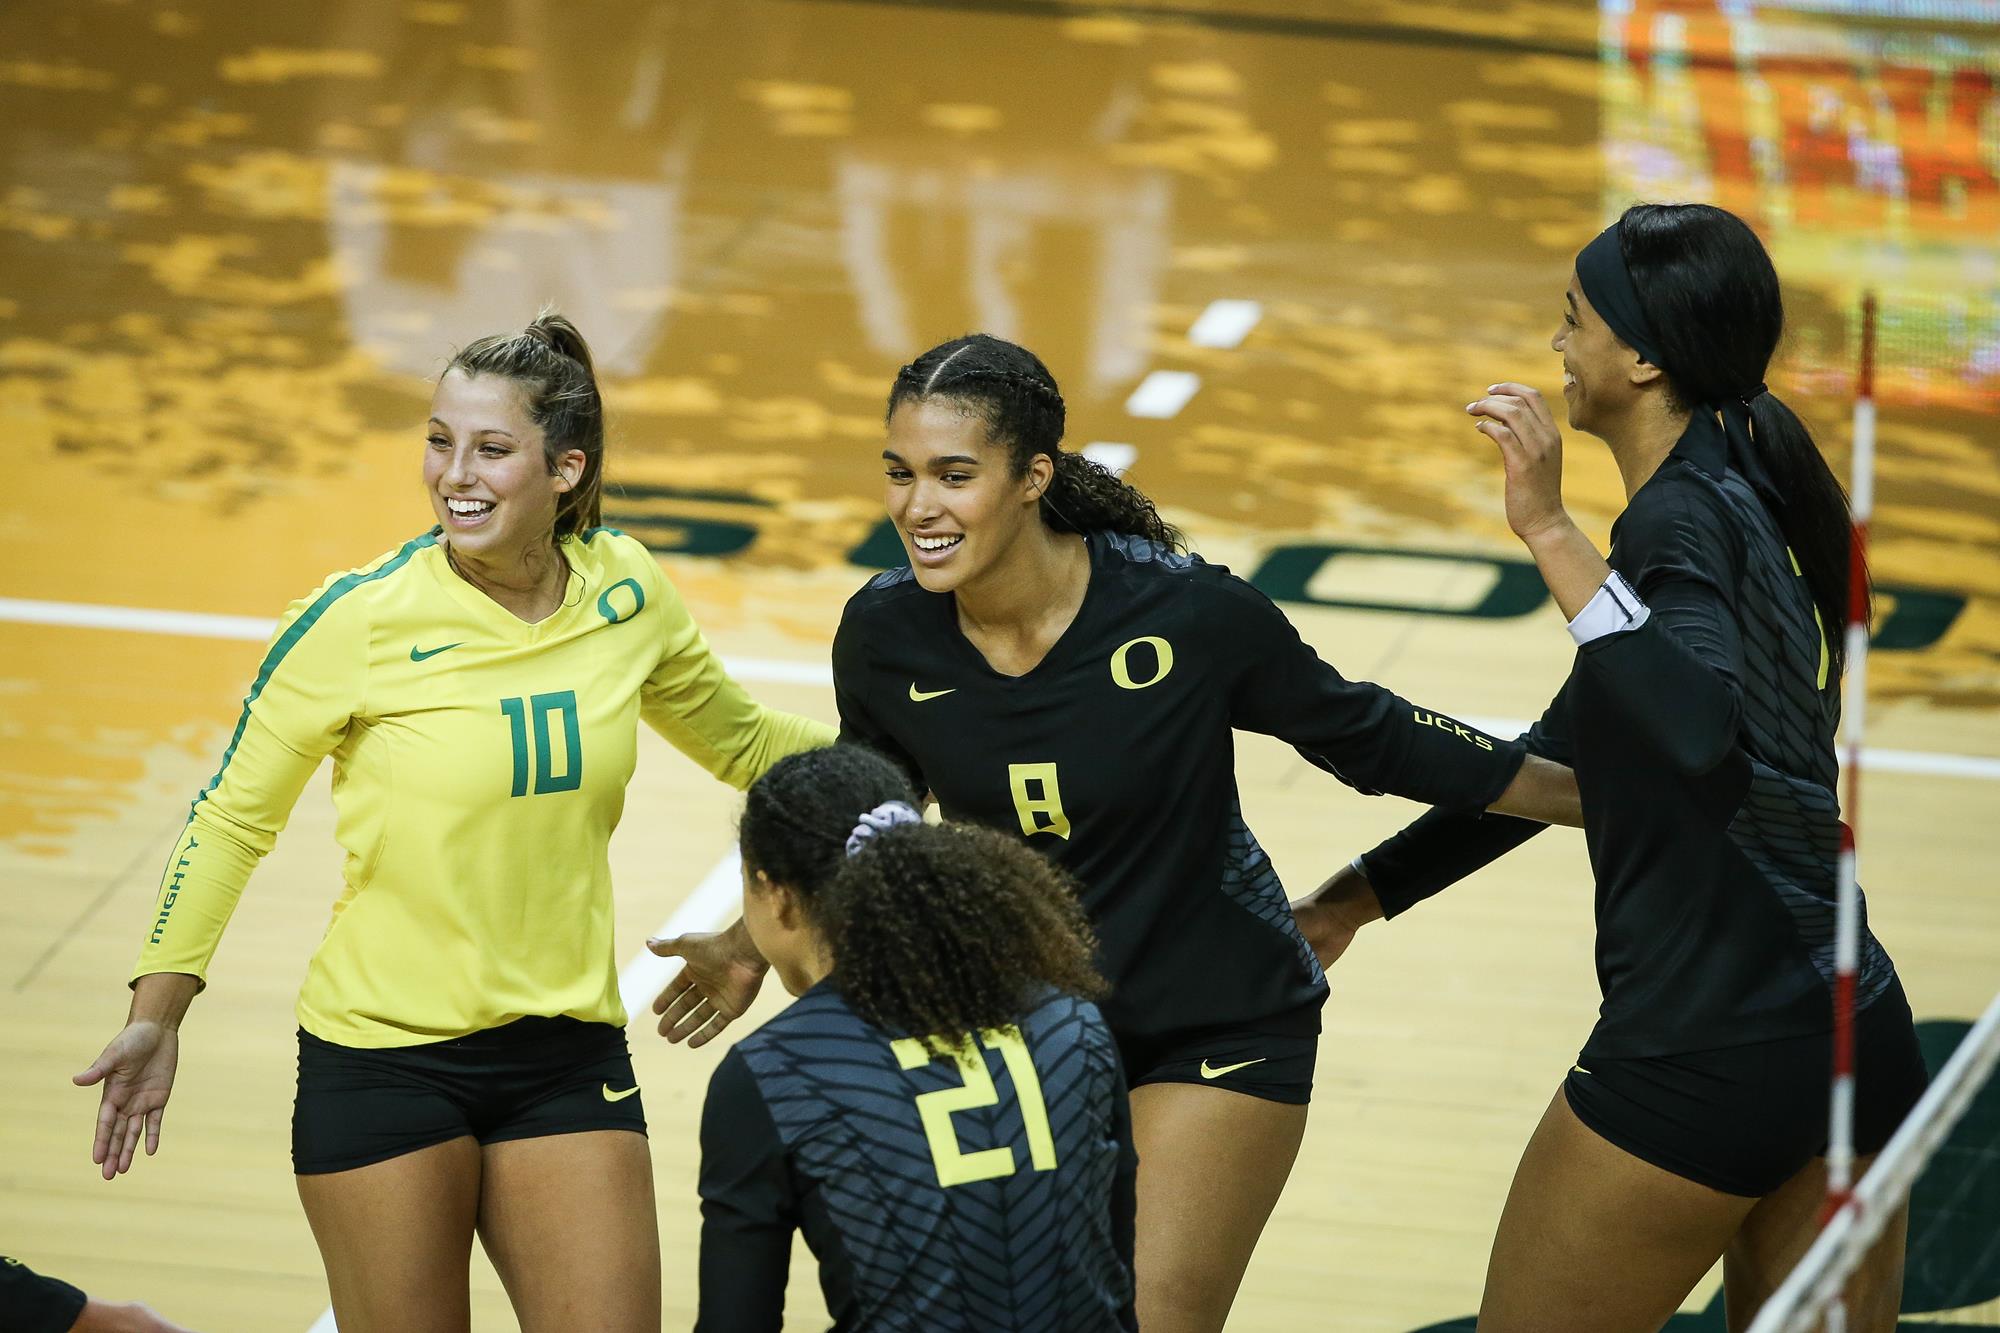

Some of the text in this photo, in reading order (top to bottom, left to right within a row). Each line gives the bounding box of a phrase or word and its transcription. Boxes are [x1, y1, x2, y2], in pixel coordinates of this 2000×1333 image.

[1110, 636, 1173, 690] O
[500, 690, 582, 797] 10
[1008, 762, 1071, 841] 8
[151, 835, 199, 944] MIGHTY
[889, 1023, 1058, 1188] 21
